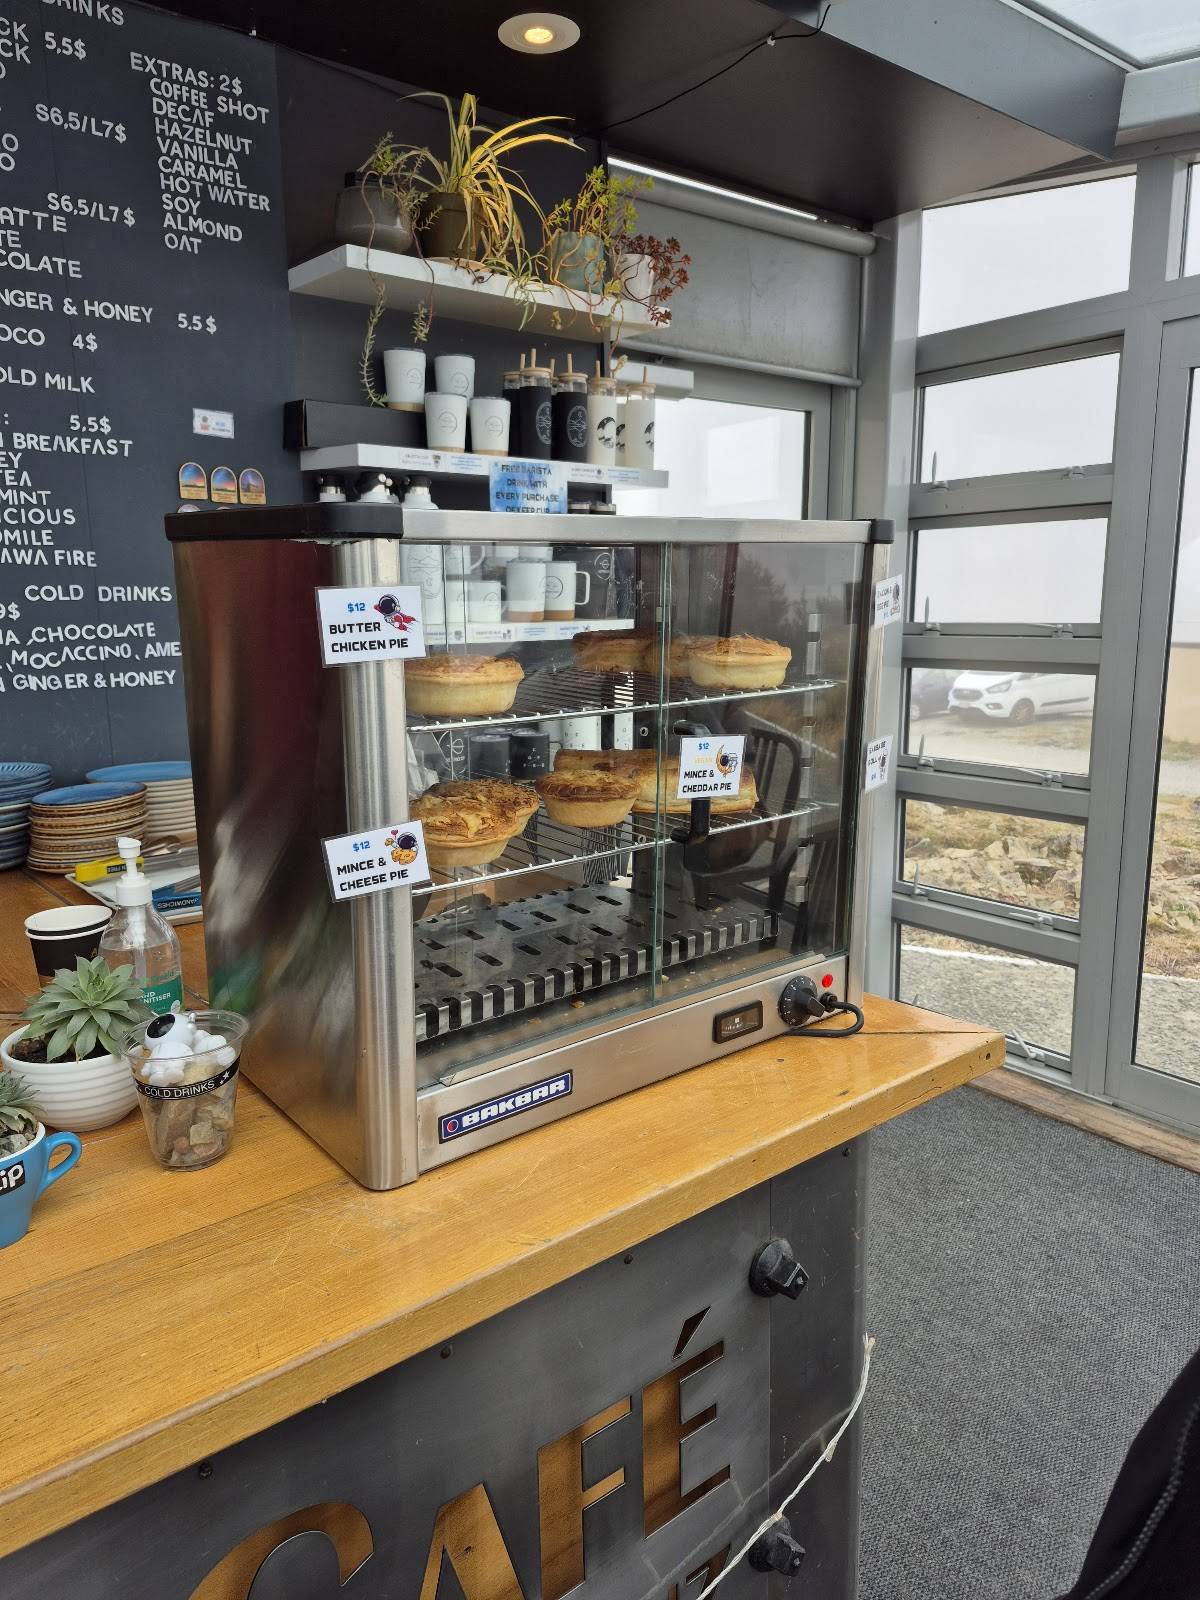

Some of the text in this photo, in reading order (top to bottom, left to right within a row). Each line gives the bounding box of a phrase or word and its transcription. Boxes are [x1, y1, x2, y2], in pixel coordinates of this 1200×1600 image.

[42, 0, 124, 26] INKS
[130, 51, 243, 96] EXTRAS: 2$
[150, 77, 270, 124] COFFEE SHOT
[152, 96, 215, 127] DECAF
[154, 117, 253, 155] HAZELNUT
[157, 136, 239, 170] VANILLA
[157, 155, 248, 189] CARAMEL
[160, 172, 271, 212] HOT WATER
[162, 193, 201, 215] SOY
[163, 212, 243, 242] ALMOND
[164, 233, 202, 254] OAT
[63, 297, 78, 315] &
[84, 299, 153, 323] HONEY
[72, 332, 98, 352] 4$
[45, 371, 96, 394] MILK
[13, 432, 133, 457] BREAKFAST
[0, 469, 32, 487] EA
[495, 491, 560, 502] EVERY PURCHASE
[0, 529, 54, 546] MILE
[54, 549, 97, 567] FIRE
[24, 585, 173, 602] COLD DRINKS
[347, 602, 366, 613] $12
[329, 621, 381, 634] BUTTER
[331, 638, 409, 653] CHICKEN PIE
[12, 672, 89, 692] GINGER
[93, 672, 108, 688] &
[110, 669, 176, 688] HONEY
[684, 769, 714, 779] MINCE &
[682, 782, 732, 793] CHEDDAR PIE
[352, 840, 371, 852] $12
[336, 857, 387, 876] MINCE &
[339, 868, 409, 892] CHEESE PIE
[143, 993, 171, 1004] NITISER
[144, 1080, 215, 1098] COLD DRINKS
[462, 1079, 566, 1128] BAKBAR
